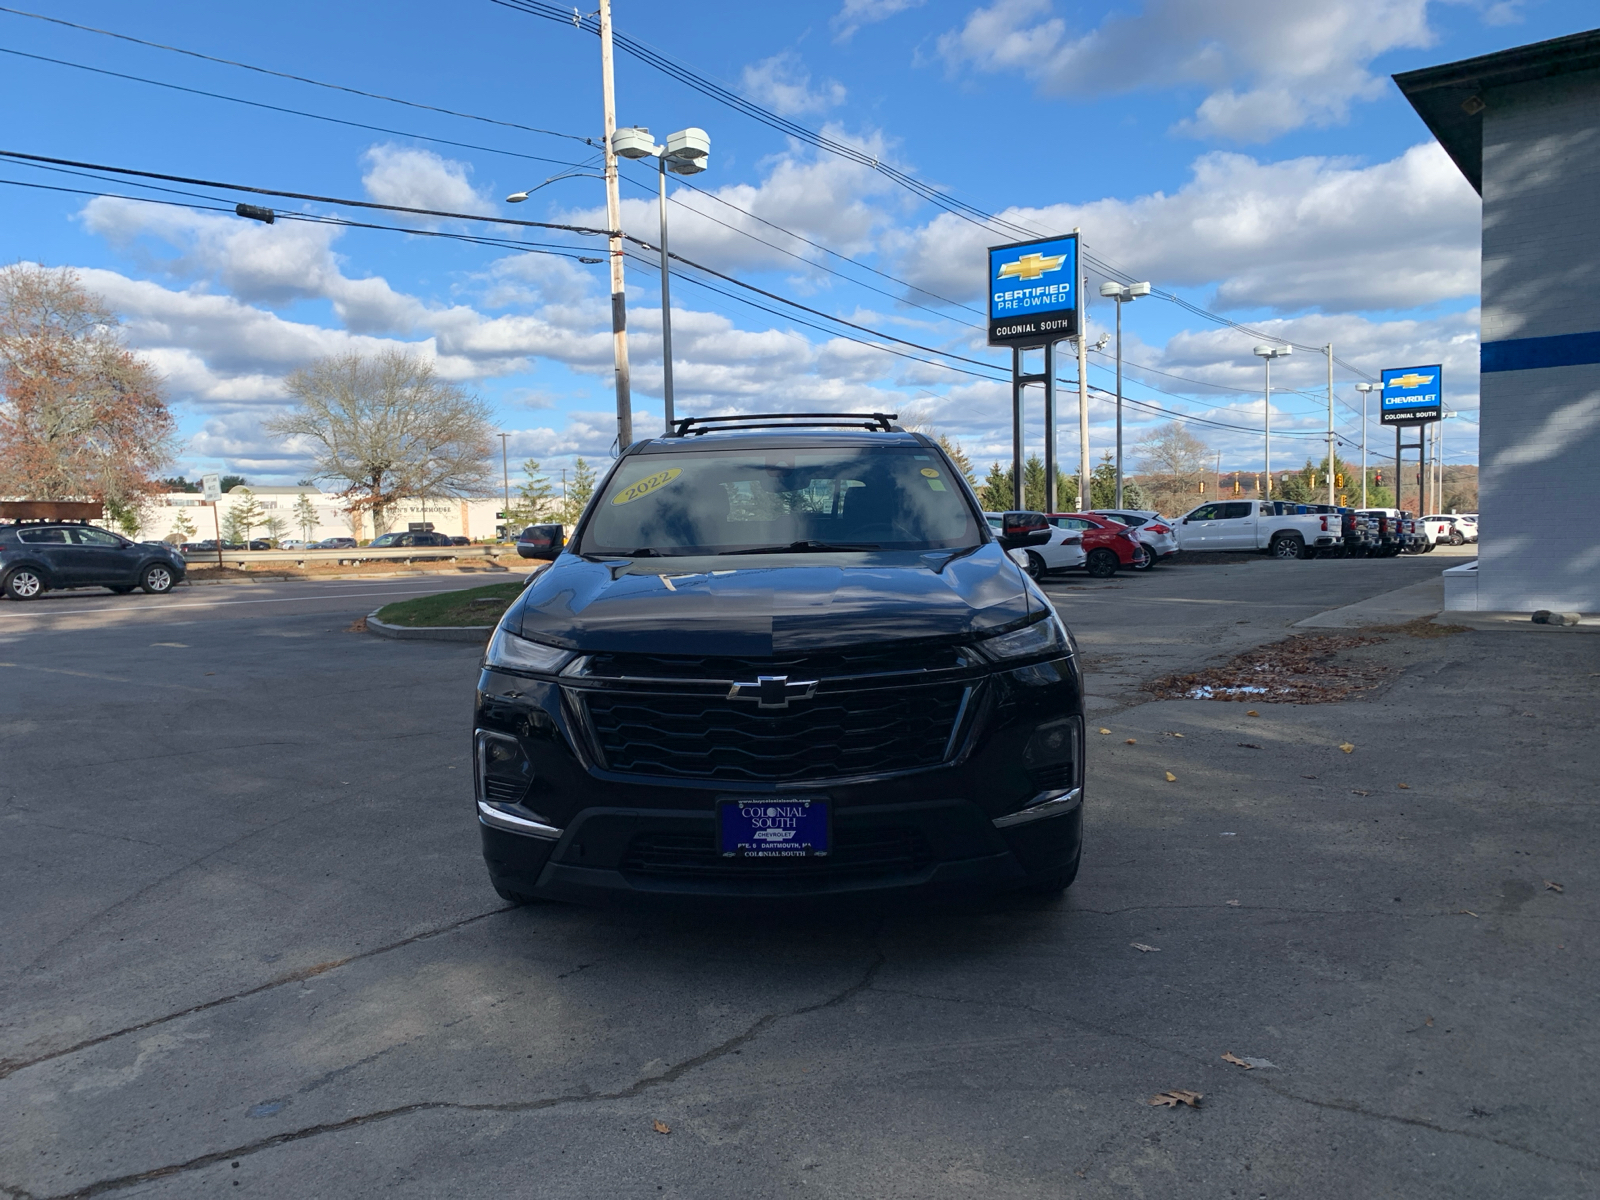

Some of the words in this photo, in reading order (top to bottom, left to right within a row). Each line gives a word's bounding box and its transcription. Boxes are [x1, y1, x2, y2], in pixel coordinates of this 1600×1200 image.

[994, 283, 1070, 302] CERTIFIED
[998, 293, 1066, 310] PRE-OWNED
[996, 324, 1036, 336] COLONIAL
[1040, 319, 1068, 331] SOUTH
[1385, 393, 1437, 405] CHEVROLET
[625, 471, 672, 501] 2022
[742, 807, 807, 818] COLONIAL
[752, 817, 797, 828] SOUTH
